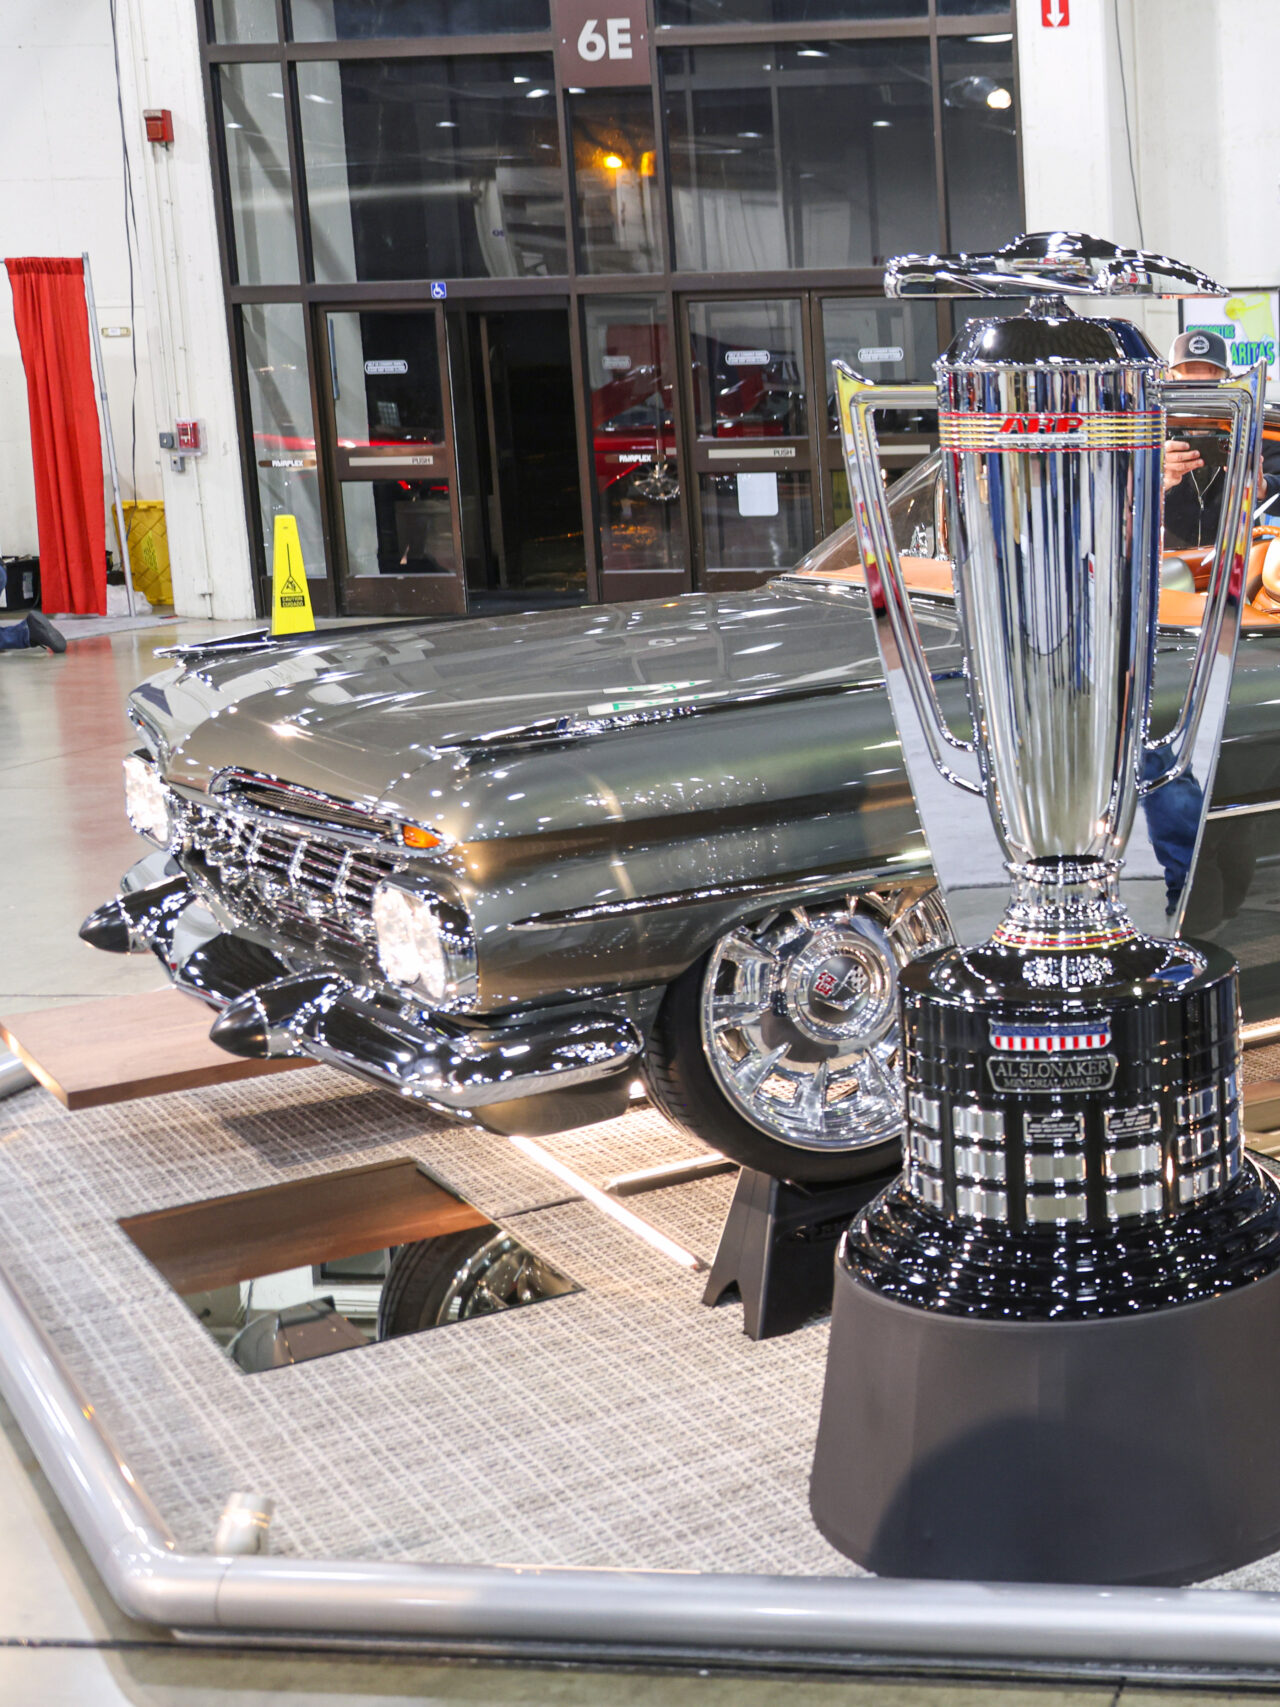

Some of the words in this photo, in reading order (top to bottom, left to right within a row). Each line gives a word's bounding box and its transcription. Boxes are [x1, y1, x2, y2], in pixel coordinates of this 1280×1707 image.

[577, 17, 633, 62] 6E
[1230, 341, 1275, 366] ARITAS
[999, 417, 1084, 433] ARP
[995, 1062, 1018, 1077] AL
[1020, 1060, 1109, 1078] SLONAKER
[1004, 1078, 1060, 1088] MEMORIAL
[1062, 1076, 1102, 1088] AWARD
